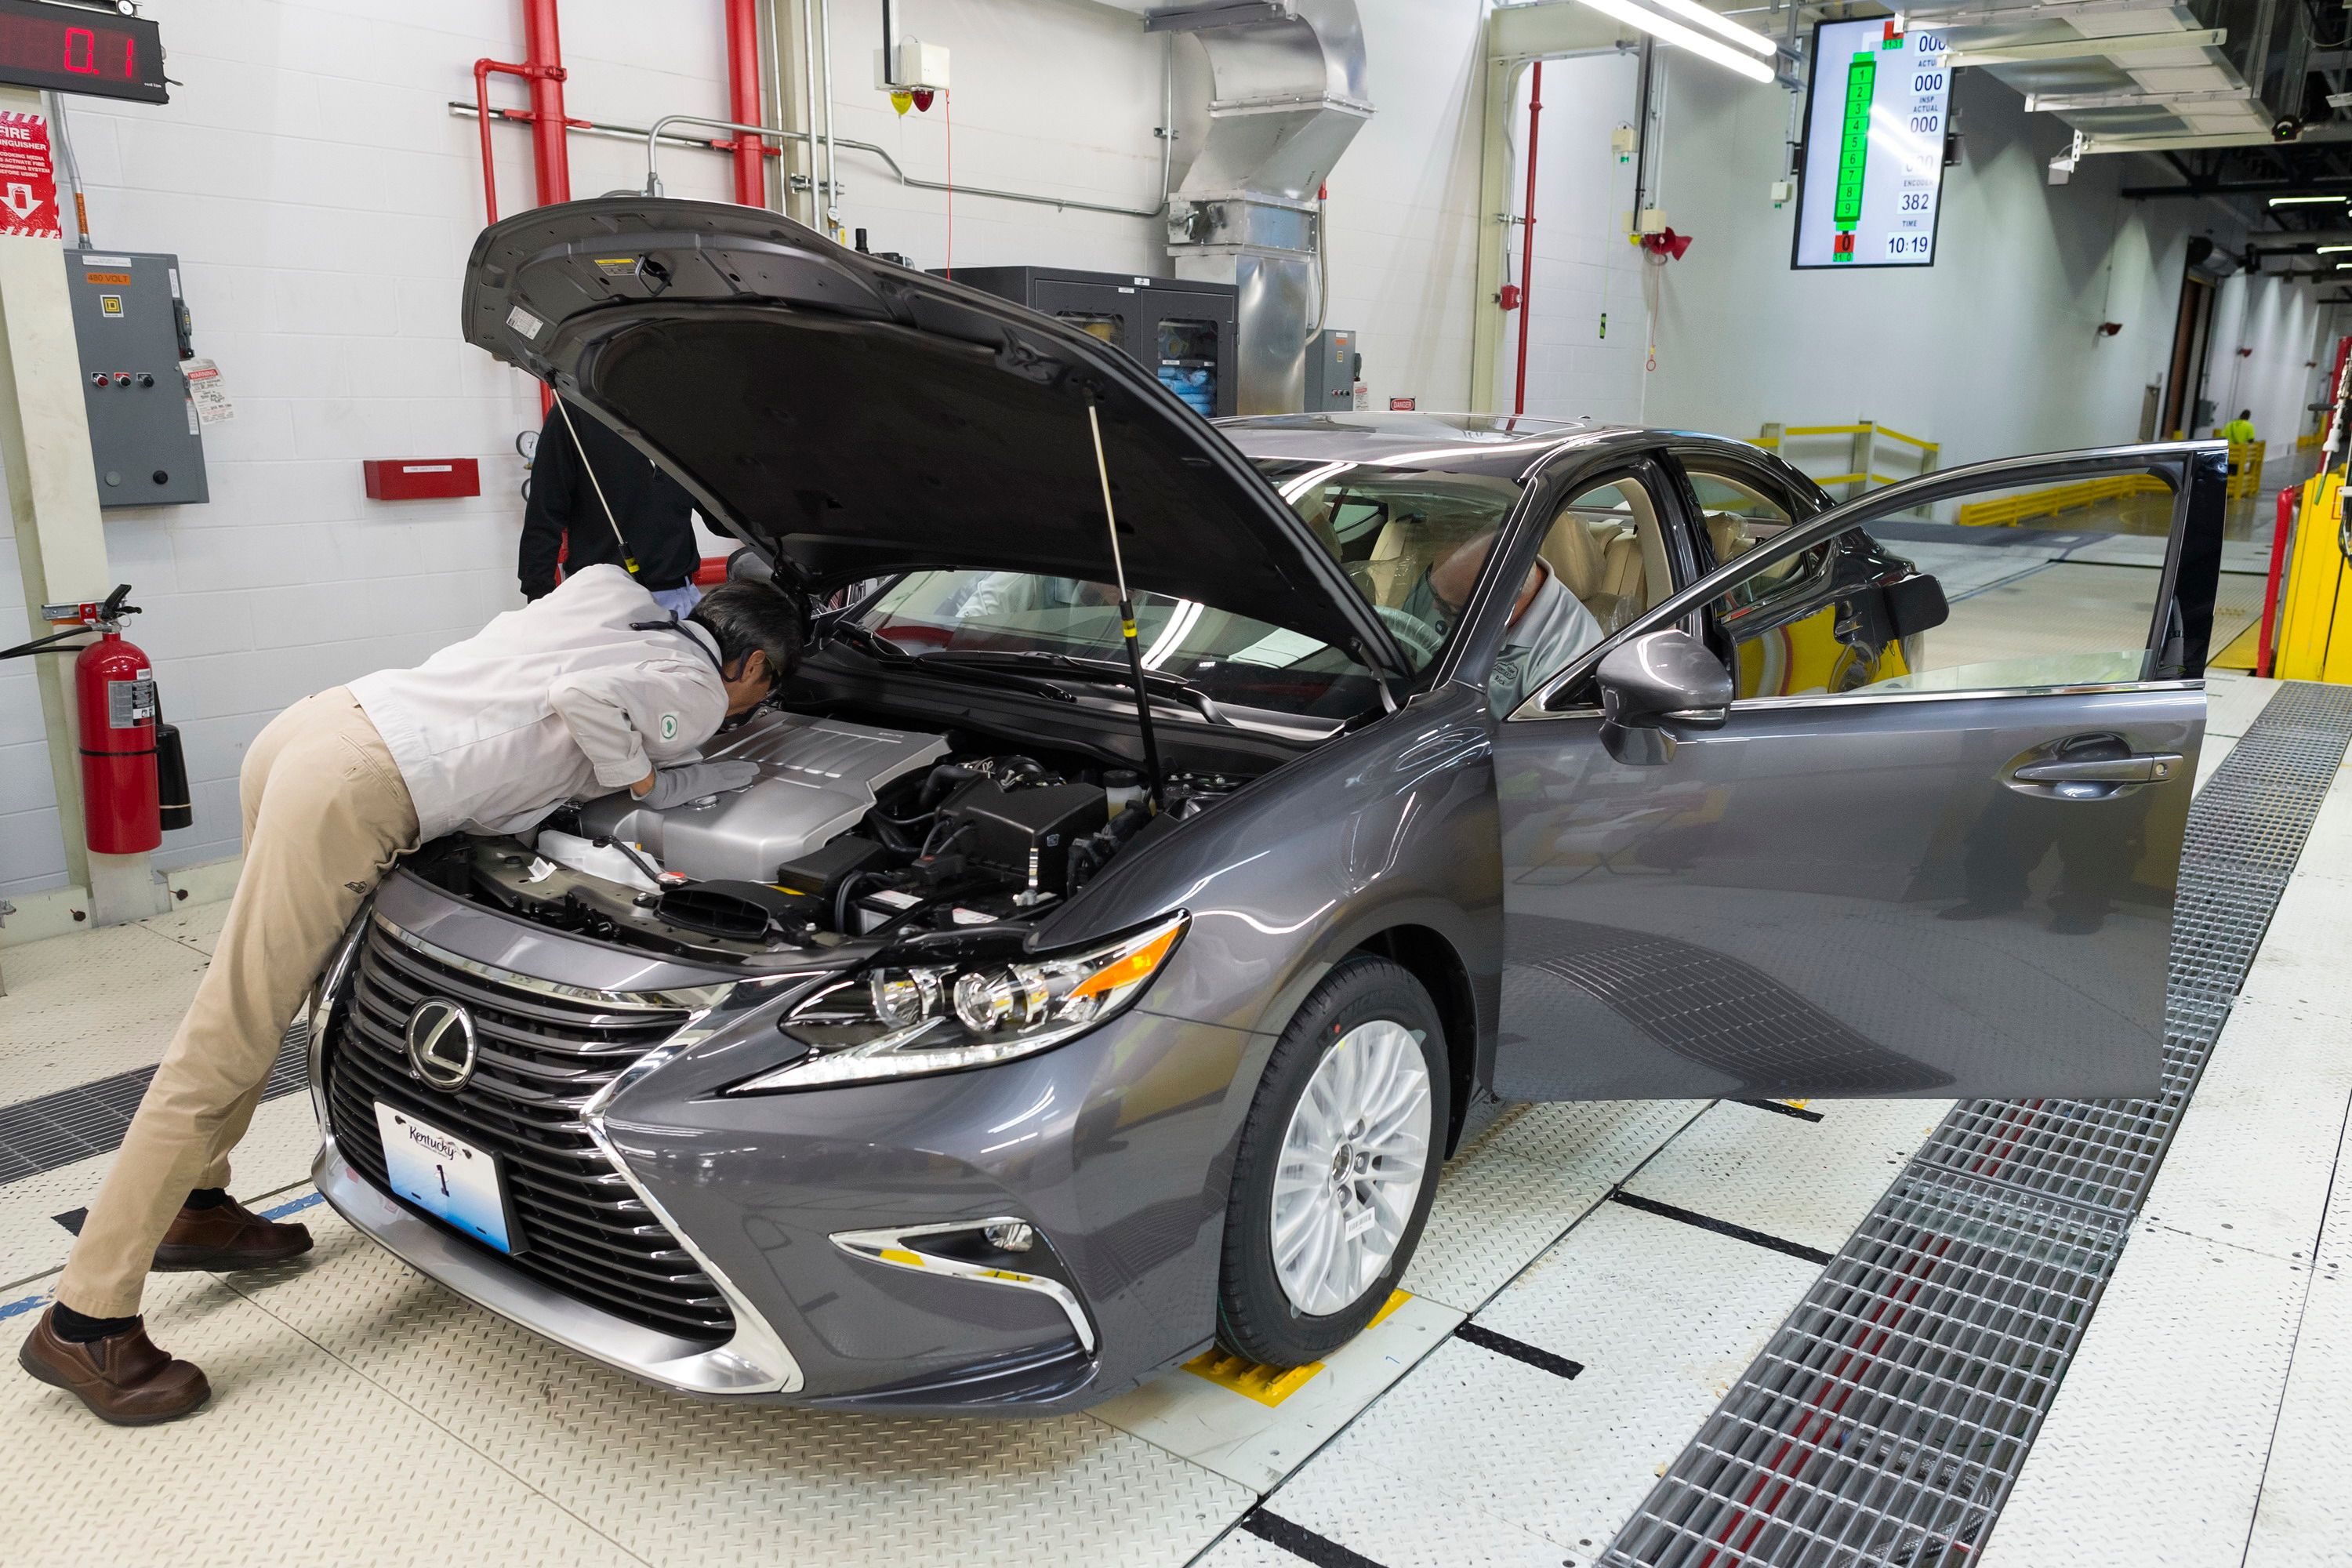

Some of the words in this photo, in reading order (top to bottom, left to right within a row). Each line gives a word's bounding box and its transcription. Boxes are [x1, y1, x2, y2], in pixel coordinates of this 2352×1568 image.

[1918, 59, 1936, 67] ACTU
[1860, 69, 1864, 81] 1
[1915, 74, 1943, 92] 000
[1857, 86, 1863, 98] 2
[1855, 103, 1861, 114] 3
[1913, 104, 1938, 113] ACTUAL
[1853, 119, 1860, 131] 4
[1911, 115, 1938, 132] 000
[1851, 136, 1857, 148] 5
[1849, 153, 1856, 165] 6
[1849, 170, 1854, 181] 7
[1846, 187, 1853, 198] 8
[1845, 202, 1851, 214] 9
[1902, 194, 1929, 210] 382
[1842, 235, 1851, 251] 0
[1889, 237, 1928, 253] 10:19
[409, 1126, 454, 1160] Kentucky
[436, 1164, 450, 1197] 1
